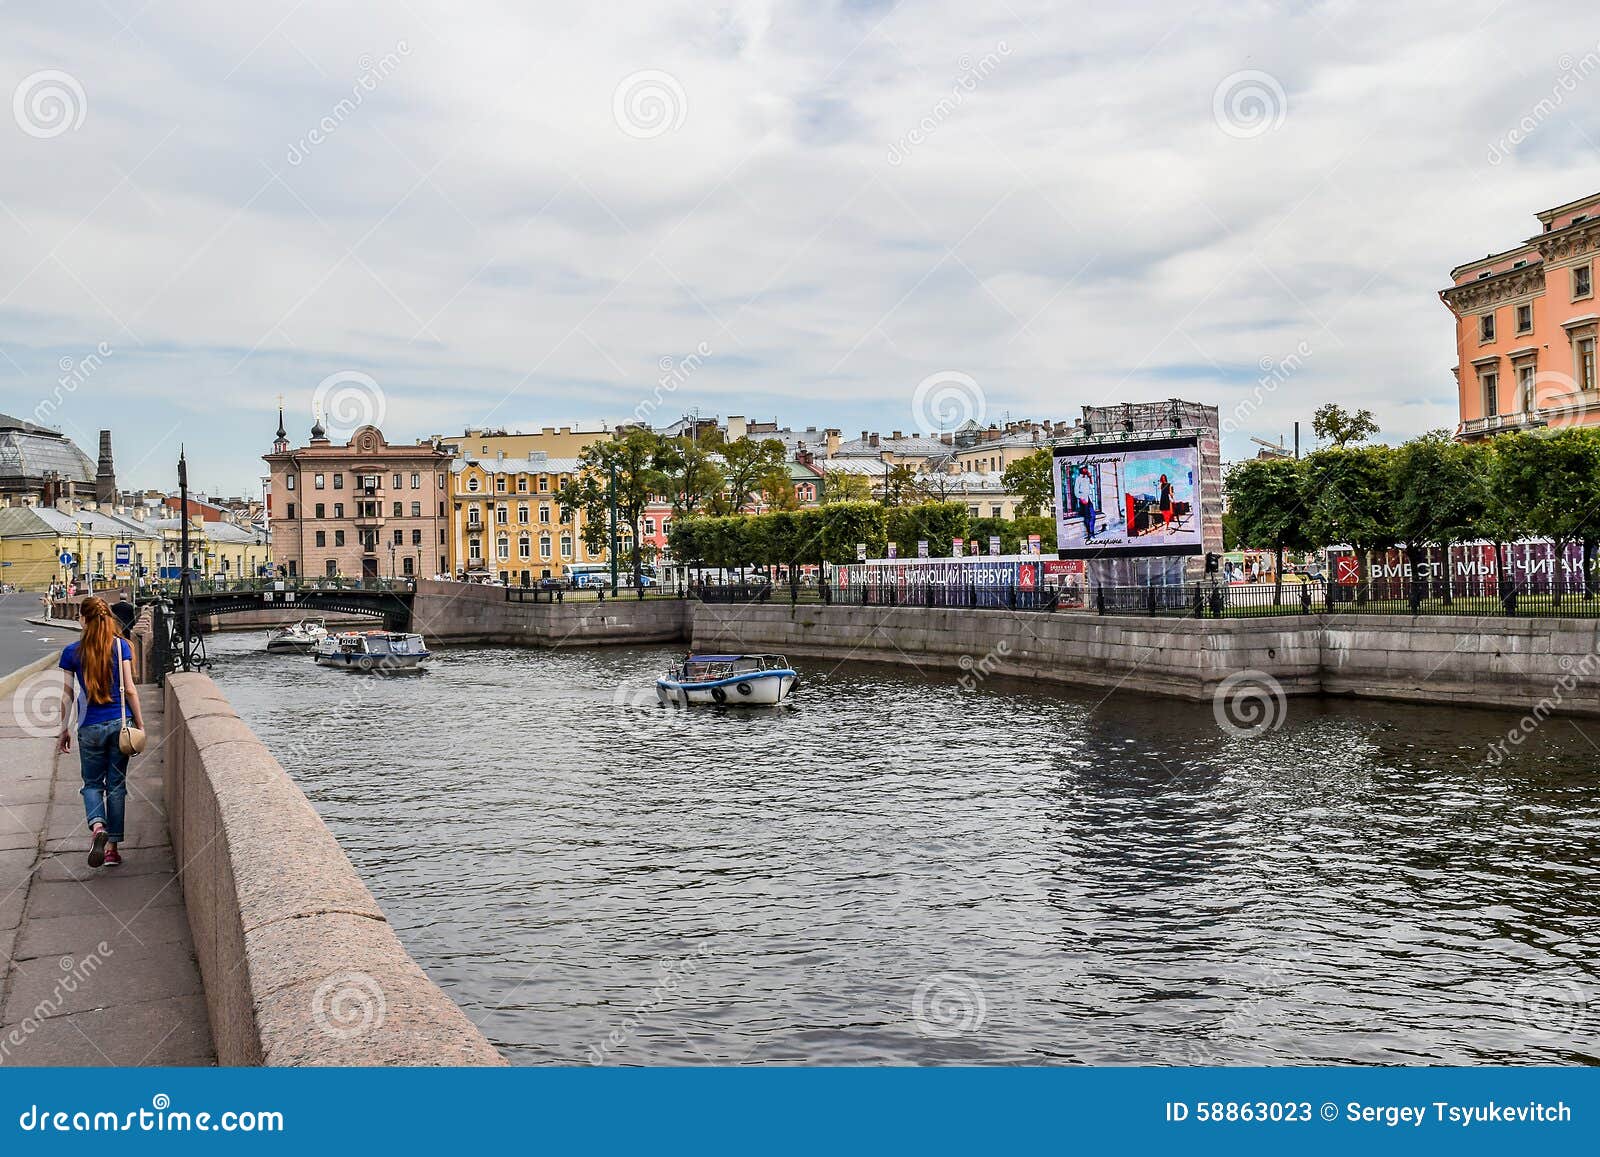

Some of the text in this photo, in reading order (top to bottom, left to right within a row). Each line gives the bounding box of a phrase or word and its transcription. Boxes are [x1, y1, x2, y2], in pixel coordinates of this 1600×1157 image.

[851, 570, 880, 585] ВМЕСТЕ
[883, 570, 897, 585] МЫ
[905, 566, 959, 586] ЧИТАЮЩИЙ
[961, 568, 1013, 585] ПЕТЕРБУРГ
[1371, 561, 1443, 578] ВМЕСТ
[1457, 561, 1495, 576] МЫ
